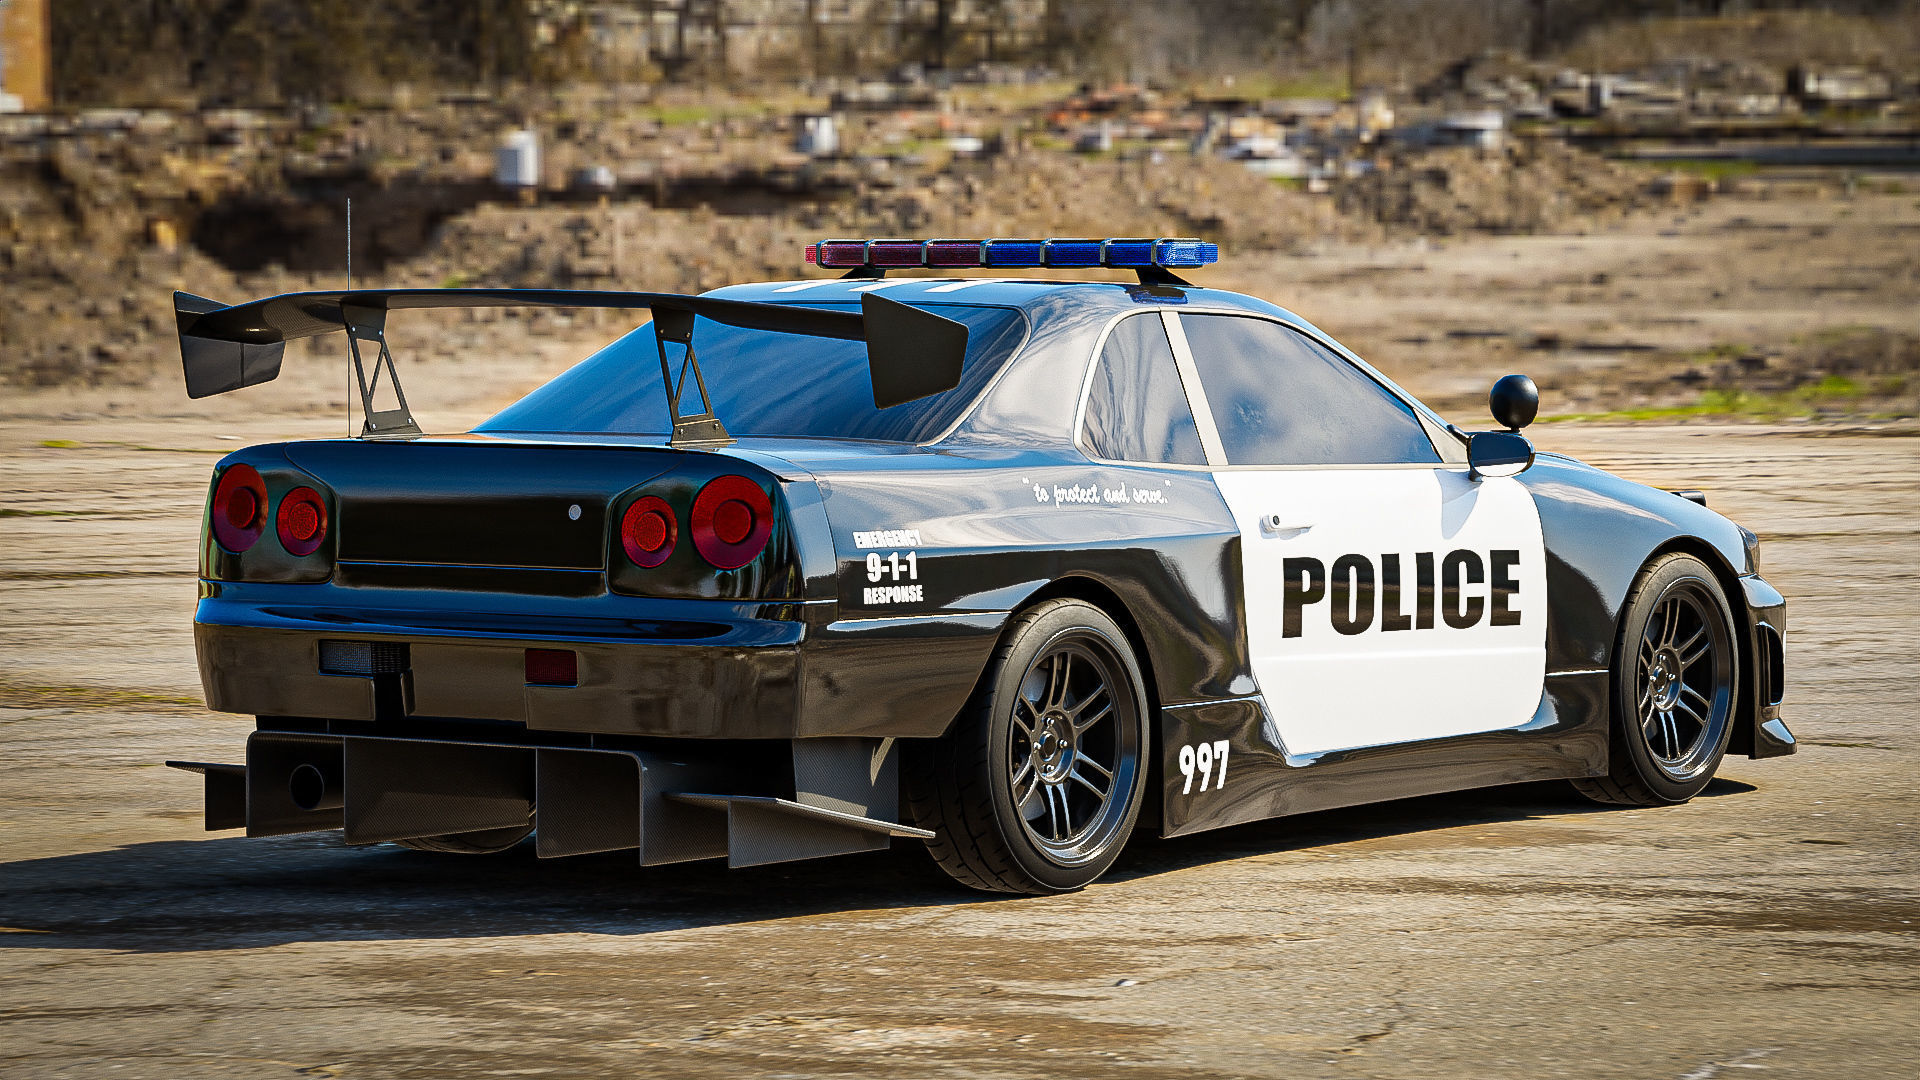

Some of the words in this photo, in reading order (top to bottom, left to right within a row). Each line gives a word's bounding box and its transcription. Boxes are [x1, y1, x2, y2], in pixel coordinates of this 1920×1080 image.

[1053, 483, 1100, 509] protect
[1103, 482, 1130, 504] and
[852, 528, 923, 549] EMERGENCY
[866, 550, 918, 583] 9-1-1
[863, 584, 924, 605] RESPONSE
[1281, 549, 1522, 639] POLICE
[1178, 739, 1230, 796] 997
